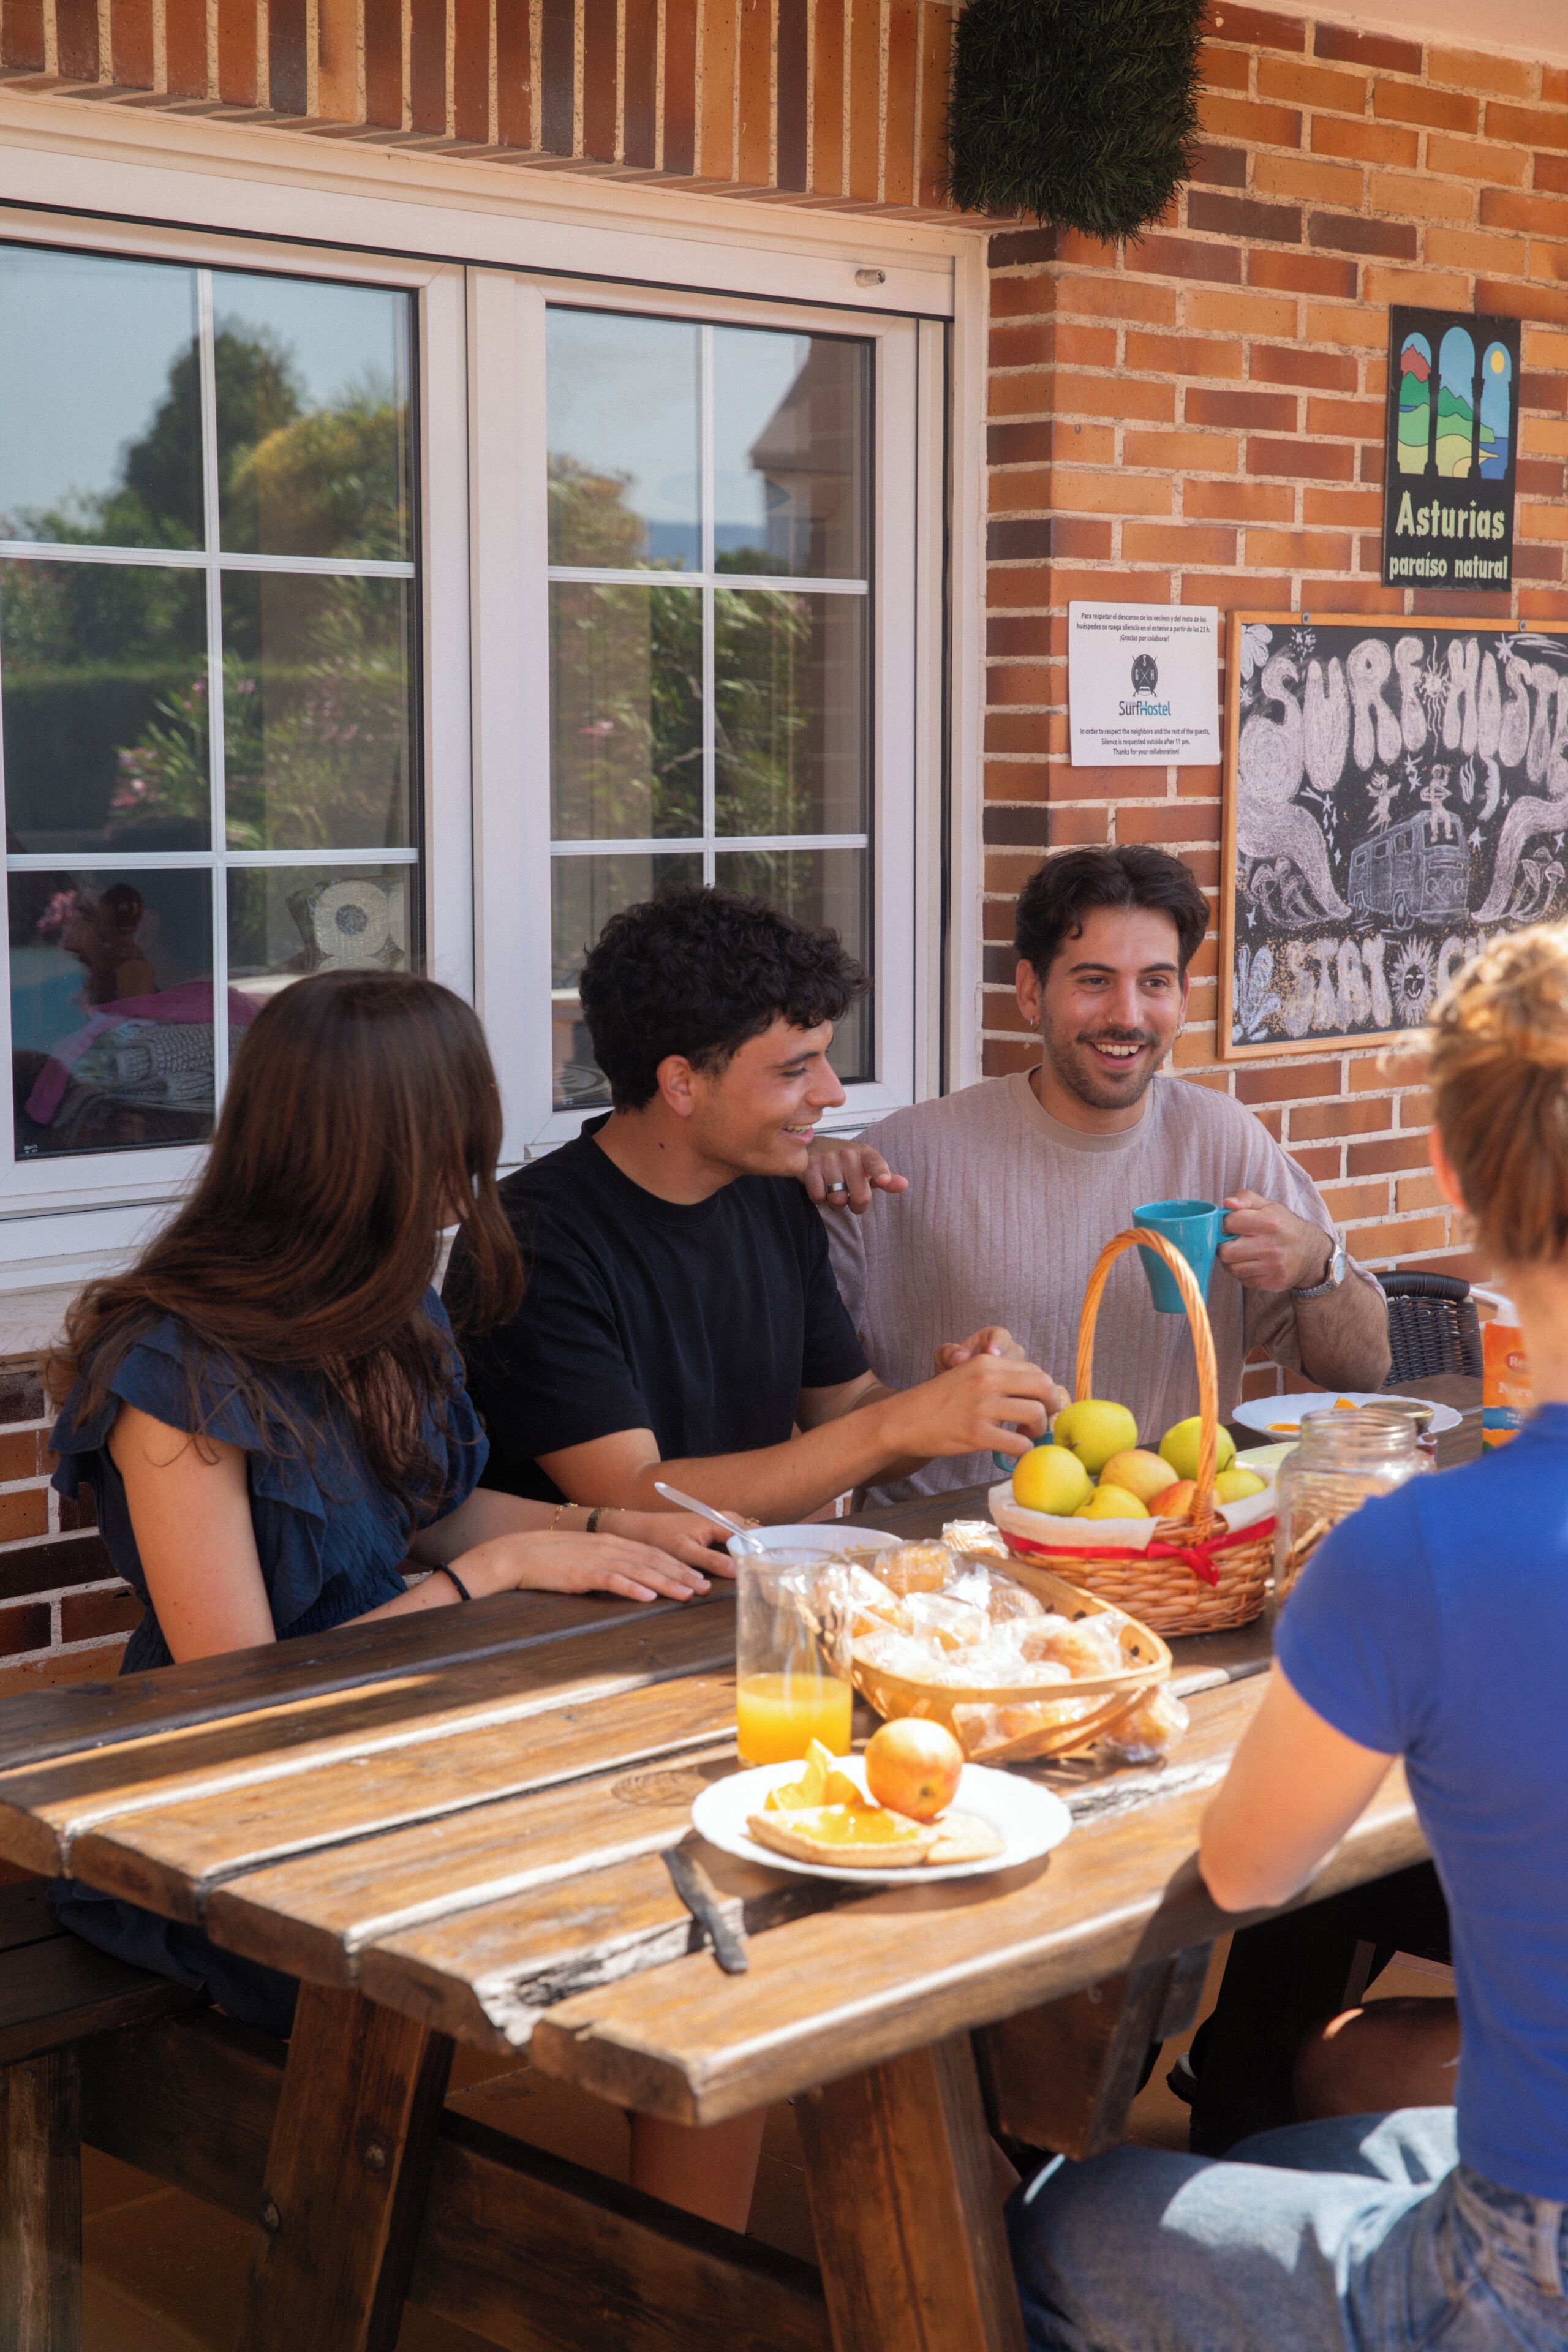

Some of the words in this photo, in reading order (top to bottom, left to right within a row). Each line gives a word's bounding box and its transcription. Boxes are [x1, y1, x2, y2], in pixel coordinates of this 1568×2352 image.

[1395, 490, 1505, 540] Asturias
[1389, 552, 1448, 581] paraíso
[1455, 554, 1508, 579] natural
[1077, 622, 1101, 631] huéspedes
[1142, 655, 1147, 666] S
[1135, 669, 1139, 680] G
[1150, 669, 1155, 680] H
[1118, 700, 1171, 716] SurfHostel
[1238, 635, 1427, 805] SURF
[1131, 728, 1153, 736] neighbors
[1123, 737, 1145, 746] requested
[1283, 934, 1393, 1038] STAY
